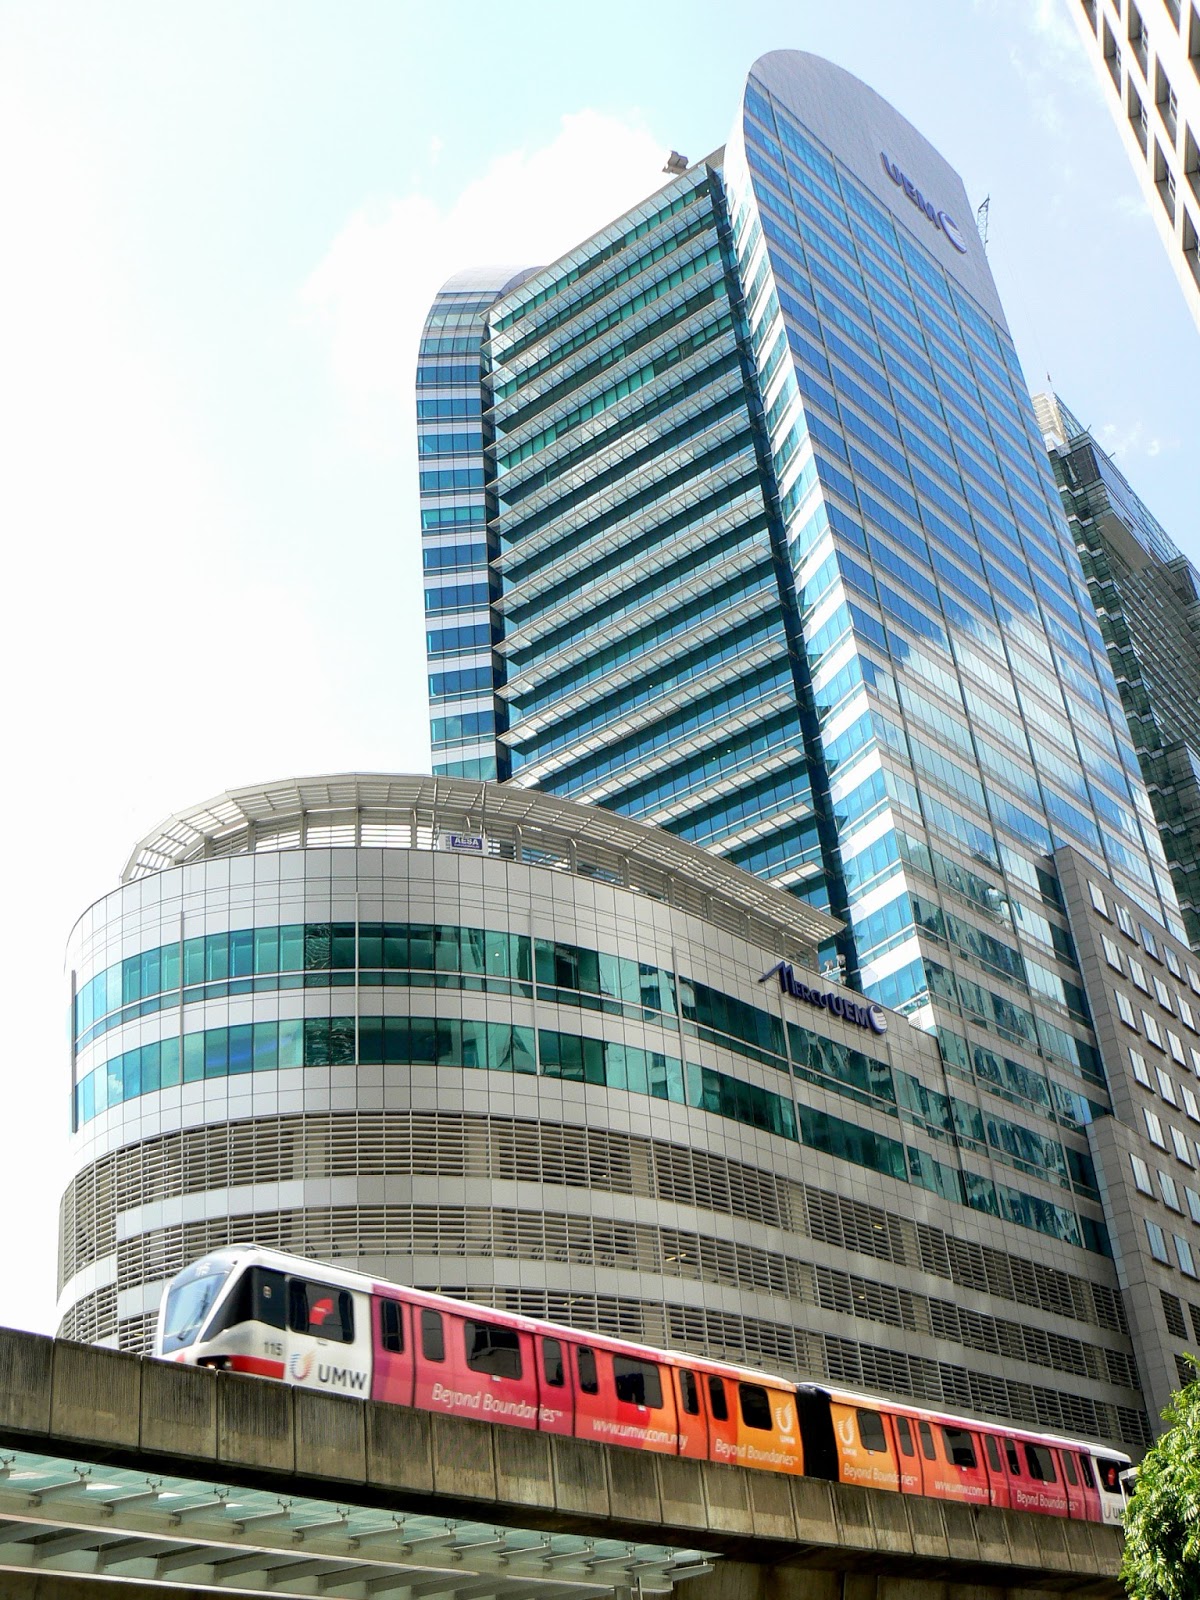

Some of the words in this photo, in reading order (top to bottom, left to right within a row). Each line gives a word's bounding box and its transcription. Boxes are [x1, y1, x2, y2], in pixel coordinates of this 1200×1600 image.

[880, 151, 941, 230] UEM
[263, 1340, 284, 1356] 115
[318, 1363, 367, 1391] UMW
[432, 1383, 481, 1408] Beyond
[715, 1438, 747, 1459] Beyond
